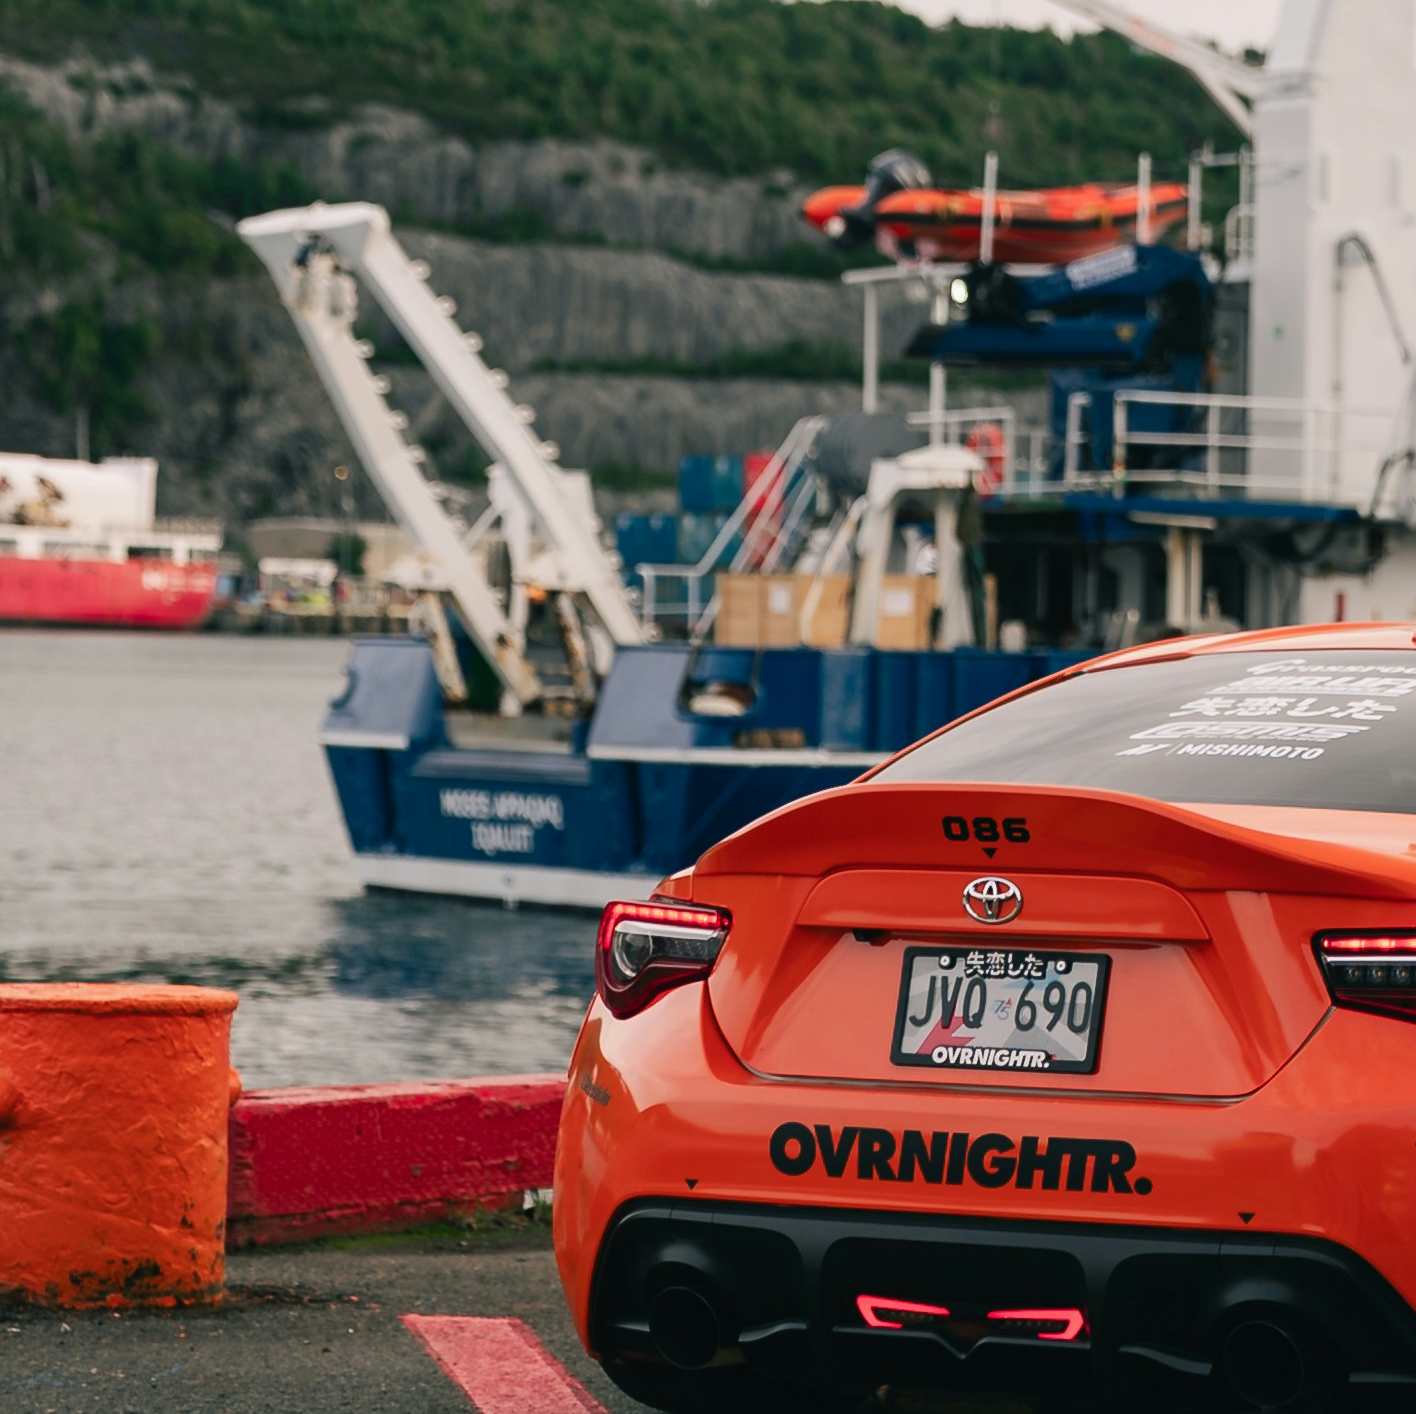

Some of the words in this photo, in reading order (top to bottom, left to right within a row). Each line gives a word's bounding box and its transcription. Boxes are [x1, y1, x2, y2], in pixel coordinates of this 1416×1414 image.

[1169, 697, 1397, 721] 失恋した
[1177, 744, 1325, 760] MISHIMOTO
[942, 816, 1030, 843] 086
[965, 951, 1043, 977] 失恋した
[909, 975, 987, 1029] JVQ
[1015, 980, 1093, 1034] 690
[932, 1046, 1050, 1069] OVRNIGHTR.
[769, 1121, 1153, 1196] OVRNIGHTR.
